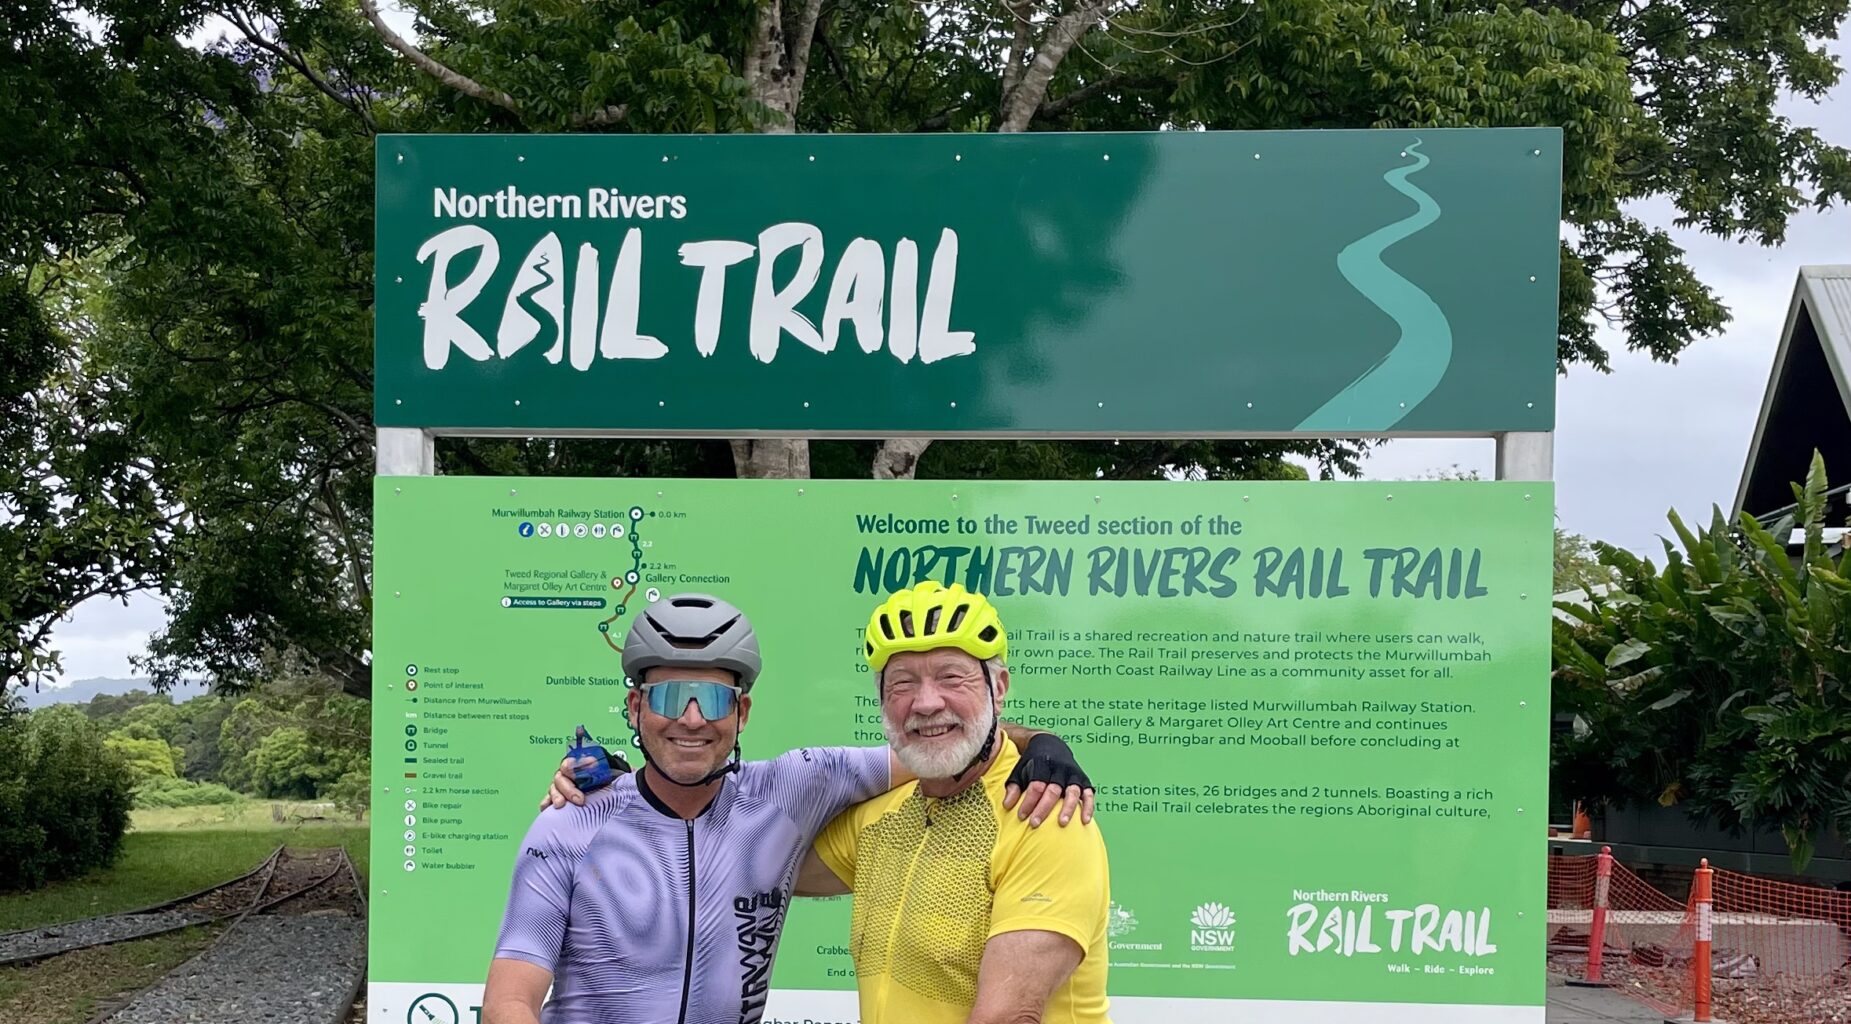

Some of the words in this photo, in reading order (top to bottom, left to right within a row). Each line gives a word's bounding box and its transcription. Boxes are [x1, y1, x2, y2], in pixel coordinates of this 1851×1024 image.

[434, 186, 581, 218] Northern
[589, 187, 686, 219] Rivers
[416, 225, 669, 371] RAIL
[678, 222, 976, 364] TRAIL
[491, 507, 555, 518] Murwillumbah
[557, 508, 592, 521] Railway
[593, 508, 625, 519] Station
[658, 510, 672, 519] 0.0
[673, 511, 687, 519] km
[855, 512, 950, 535] Welcome
[956, 516, 978, 535] to
[983, 513, 1018, 535] the
[1023, 513, 1091, 535] Tweed
[1097, 515, 1173, 536] section
[1180, 514, 1204, 536] of
[1207, 514, 1243, 536] the
[649, 562, 662, 571] 2.2
[663, 562, 677, 570] km
[504, 569, 532, 579] Tweed
[533, 569, 569, 582] Regional
[569, 569, 599, 582] Gallery
[599, 570, 607, 580] &
[1087, 546, 1241, 598] RIVERS
[1253, 547, 1349, 600] RAIL
[1363, 547, 1488, 600] TRAIL
[645, 573, 677, 586] Gallery
[679, 573, 730, 584] Connection
[503, 581, 541, 593] Margaret
[541, 581, 563, 594] Olley
[564, 582, 578, 592] Art
[579, 582, 608, 592] Centre
[1025, 629, 1055, 641] Trail
[1059, 629, 1070, 642] is
[1073, 632, 1081, 641] a
[1084, 629, 1133, 642] shared
[1137, 630, 1208, 643] recreation
[1212, 630, 1240, 643] and
[1243, 632, 1291, 643] nature
[1294, 631, 1322, 643] trail
[1325, 631, 1372, 643] where
[1375, 634, 1414, 644] users
[1416, 634, 1443, 644] can
[1446, 631, 1485, 646] walk,
[1023, 648, 1054, 658] own
[1058, 649, 1096, 661] pace.
[1097, 647, 1125, 659] The
[1128, 647, 1154, 659] Rail
[1157, 647, 1187, 659] Trail
[1191, 650, 1260, 662] preserves
[1262, 647, 1290, 660] and
[1294, 649, 1354, 663] protects
[1357, 648, 1382, 661] the
[1385, 649, 1492, 662] Murwillumbah
[423, 666, 441, 674] Rest
[442, 667, 460, 676] stop
[423, 681, 444, 689] Point
[444, 681, 454, 689] of
[454, 681, 484, 690] interest
[545, 675, 586, 686] Dunbible
[588, 676, 620, 686] Station
[423, 696, 457, 704] Distance
[457, 696, 477, 705] from
[477, 697, 533, 705] Murwillumbah
[854, 695, 880, 707] The
[1029, 697, 1061, 710] here
[1063, 699, 1078, 710] at
[1081, 697, 1105, 710] the
[1108, 699, 1144, 710] state
[1147, 698, 1207, 714] heritage
[1210, 698, 1249, 712] listed
[1253, 699, 1358, 712] Murwillumbah
[1361, 700, 1417, 716] Railway
[1420, 701, 1476, 713] Station.
[405, 711, 418, 719] km
[423, 711, 457, 719] Distance
[457, 712, 492, 720] between
[508, 713, 530, 721] stops
[854, 712, 864, 724] It
[1028, 714, 1090, 730] Regional
[1093, 715, 1143, 730] Gallery
[1145, 715, 1155, 728] &
[1159, 716, 1224, 731] Margaret
[1227, 716, 1264, 731] Olley
[1266, 717, 1289, 729] Art
[1292, 717, 1341, 730] Centre
[1344, 717, 1372, 730] and
[1375, 717, 1448, 731] continues
[423, 726, 449, 736] Bridge
[422, 741, 449, 749] Tunnel
[529, 734, 564, 745] Stokers
[594, 735, 628, 746] Station
[422, 756, 449, 764] Sealed
[449, 757, 465, 765] trail
[422, 771, 447, 779] Gravel
[447, 772, 463, 780] trail
[422, 786, 434, 794] 2.2
[434, 786, 448, 794] km
[448, 787, 471, 795] horse
[471, 787, 500, 795] section
[1111, 784, 1161, 796] station
[1164, 784, 1199, 798] sites,
[1202, 785, 1220, 797] 26
[1223, 785, 1278, 800] bridges
[1280, 786, 1308, 798] and
[1311, 786, 1320, 798] 2
[1323, 786, 1382, 799] tunnels.
[1385, 787, 1450, 803] Boasting
[1453, 790, 1462, 800] a
[1466, 787, 1493, 800] rich
[422, 801, 439, 809] Bike
[439, 802, 462, 810] repair
[422, 816, 439, 824] Bike
[439, 818, 463, 826] pump
[421, 831, 447, 840] E-bike
[447, 832, 481, 842] charging
[482, 833, 509, 841] station
[421, 846, 443, 855] Toilet
[421, 861, 445, 869] Water
[1293, 888, 1350, 903] Northern
[1350, 890, 1389, 903] Rivers
[1287, 903, 1381, 957] RAIL
[1385, 904, 1497, 956] TRAIL
[1191, 929, 1236, 946] NSW
[1108, 940, 1163, 951] Government
[827, 968, 847, 977] End
[1387, 963, 1411, 973] Walk
[1424, 964, 1446, 974] Ride
[1458, 965, 1495, 977] Explore
